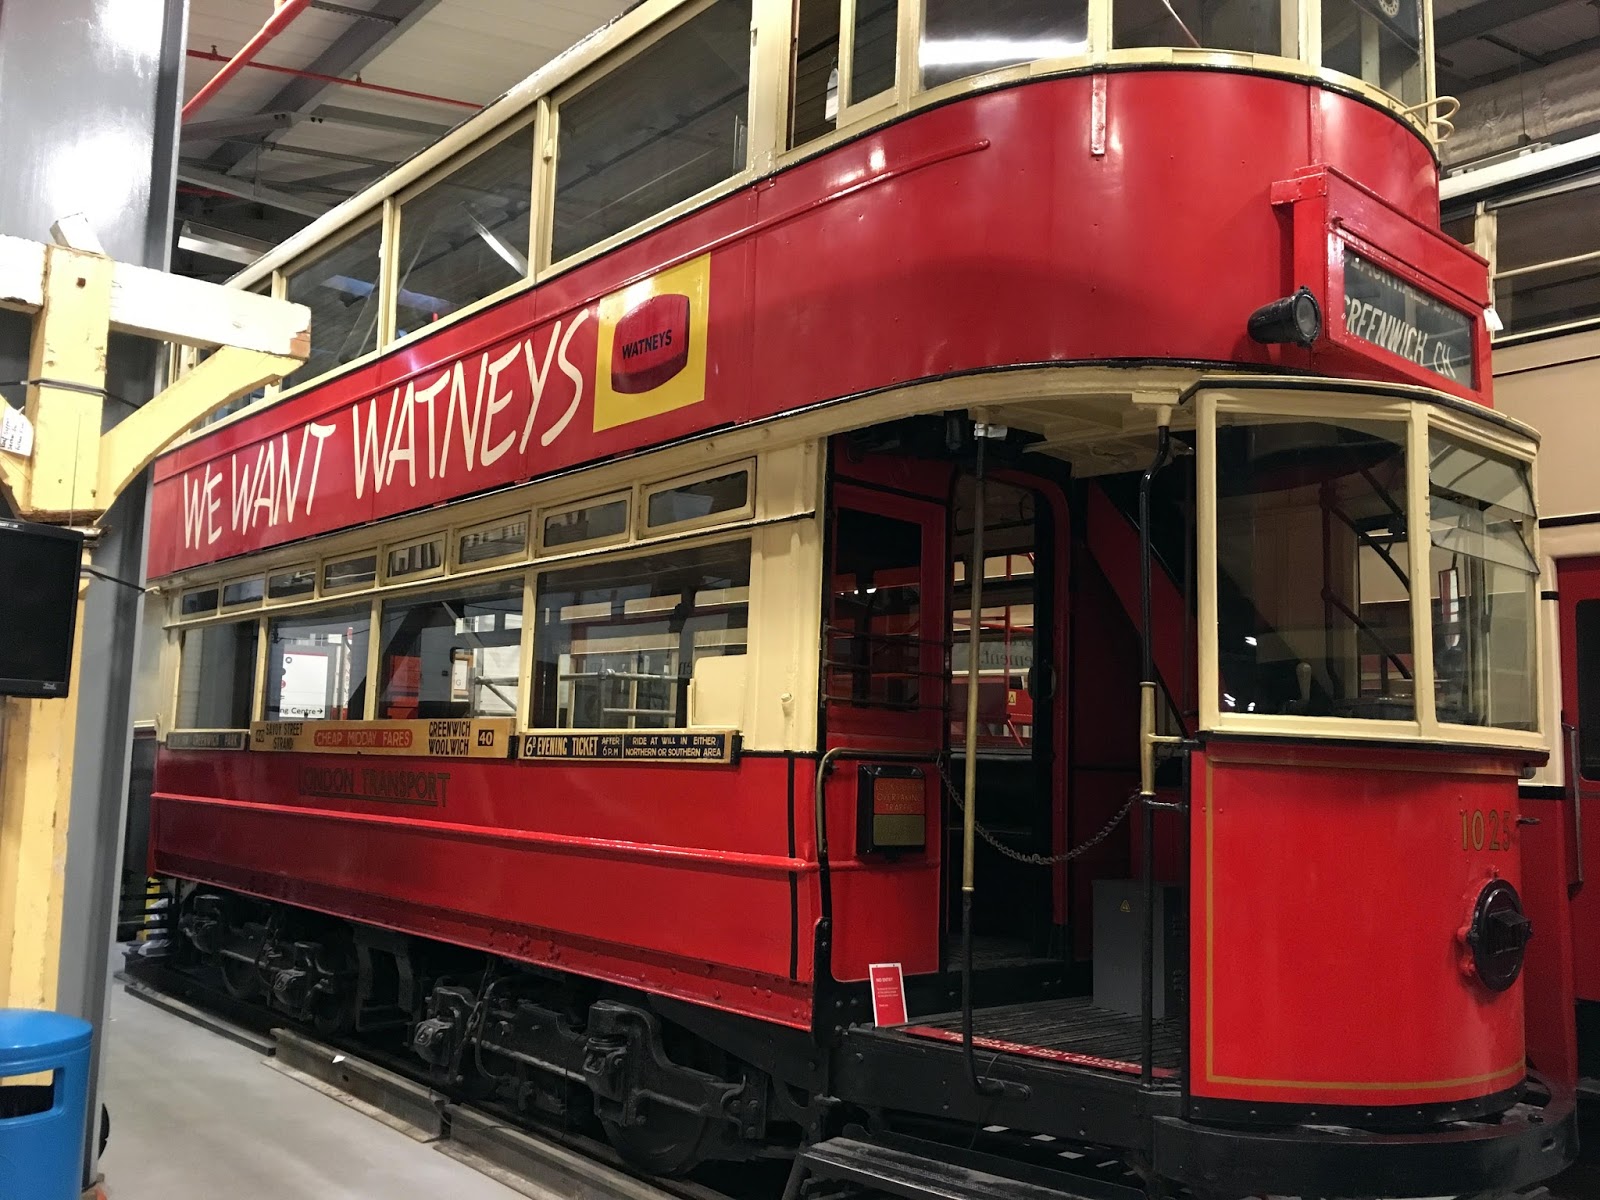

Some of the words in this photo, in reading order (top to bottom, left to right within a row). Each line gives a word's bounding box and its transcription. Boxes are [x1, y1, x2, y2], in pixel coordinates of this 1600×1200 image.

[622, 329, 672, 360] WATNEYS
[183, 463, 223, 550] WE
[231, 421, 337, 537] WANT
[352, 308, 590, 500] WATNEYS
[284, 723, 303, 735] STREET
[429, 721, 471, 737] GREENWICH
[316, 731, 343, 745] CHEAP
[347, 731, 377, 745] MIDDAY
[382, 731, 410, 747] FARES
[429, 738, 470, 755] WOOLWICH
[479, 731, 493, 746] 40
[537, 737, 567, 756] EVENING
[572, 736, 599, 756] TICKET
[601, 737, 620, 745] AFTER
[632, 737, 647, 745] RIDE
[650, 736, 658, 745] AT
[661, 737, 675, 745] WILL
[680, 736, 687, 745] IN
[693, 736, 716, 745] EITHER
[625, 748, 657, 756] NORTHERN
[658, 748, 667, 756] OR
[668, 748, 700, 756] SOUTHERN
[703, 748, 721, 756] AREA
[300, 766, 354, 795] LONDON
[362, 768, 450, 808] TRANSPORT
[1461, 809, 1511, 851] 1025
